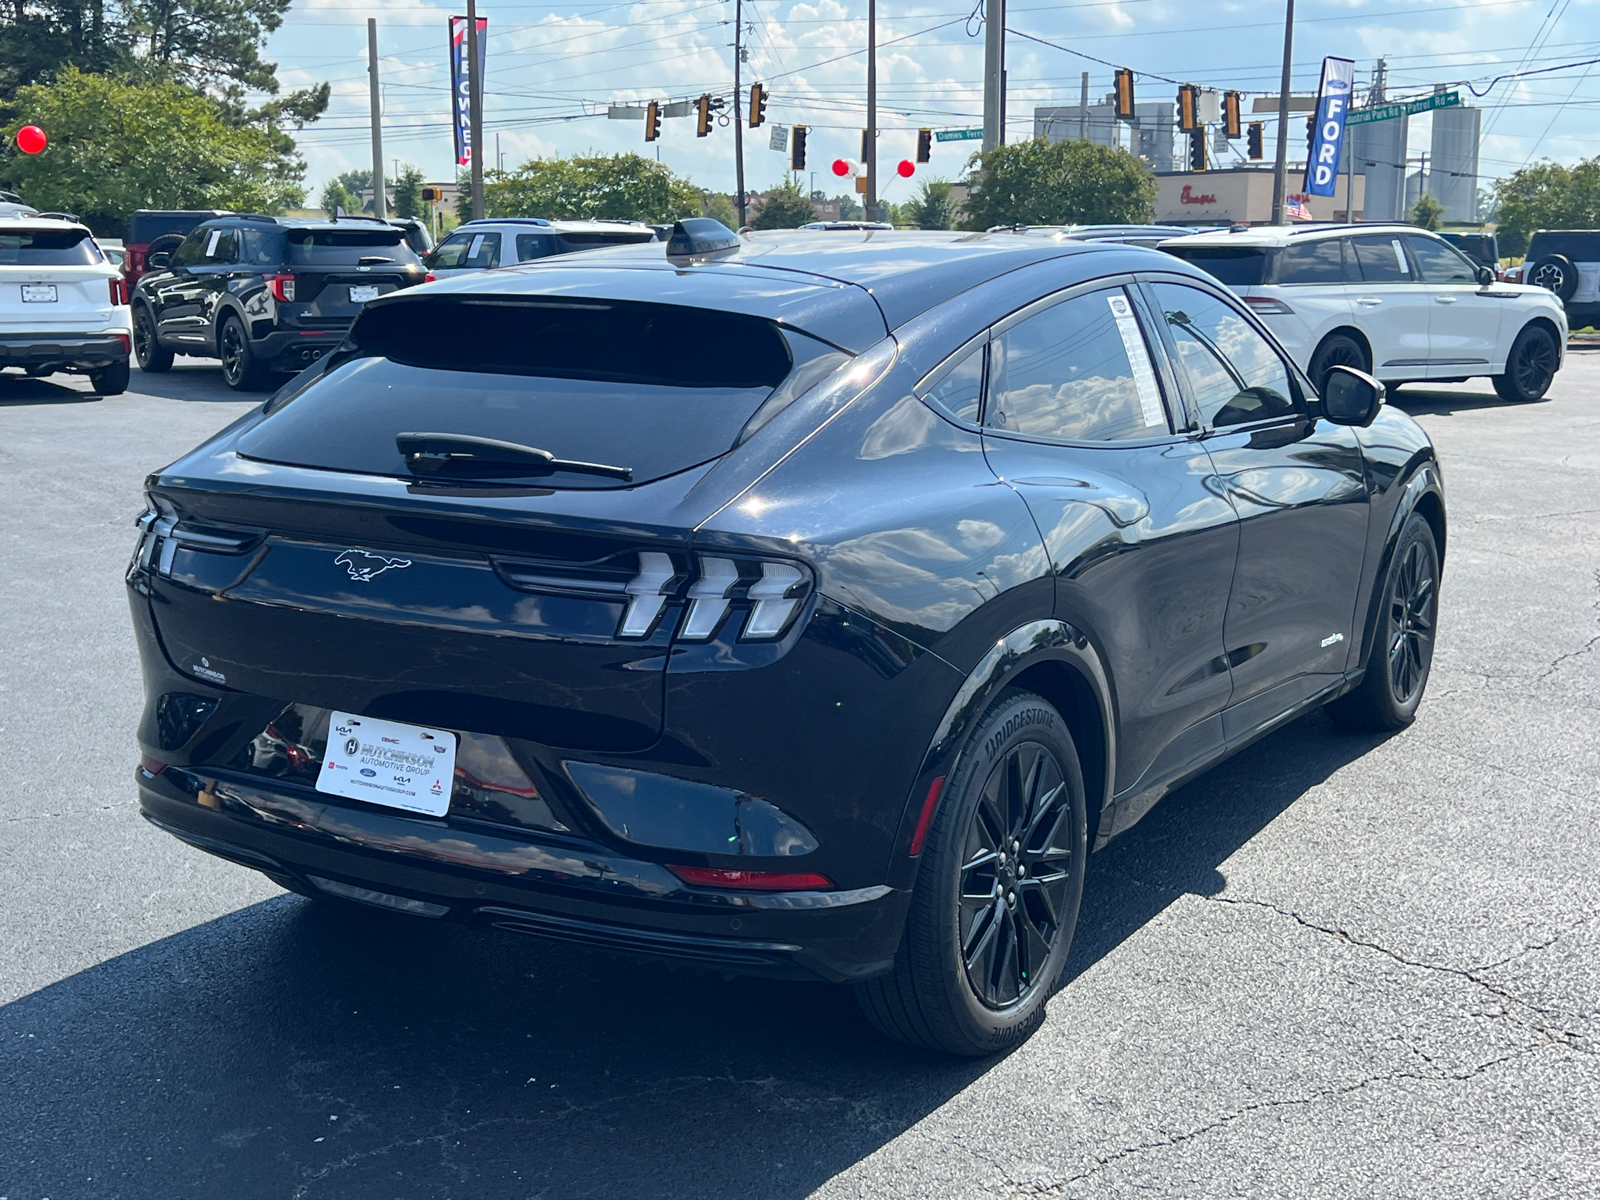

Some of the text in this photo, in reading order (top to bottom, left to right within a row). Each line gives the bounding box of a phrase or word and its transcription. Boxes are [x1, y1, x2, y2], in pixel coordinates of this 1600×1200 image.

[1372, 110, 1387, 120] Park
[1388, 107, 1399, 117] Rd
[1407, 96, 1446, 113] Patrol Rd
[938, 132, 963, 140] Dames
[1315, 99, 1343, 185] FORD
[984, 707, 1055, 764] BRIDGESTONE
[361, 744, 435, 768] HUTCHINSON
[360, 756, 430, 776] AUTOMOTIVE GROUP
[350, 779, 416, 796] HUTCHINSONAUTOGROUP.COM
